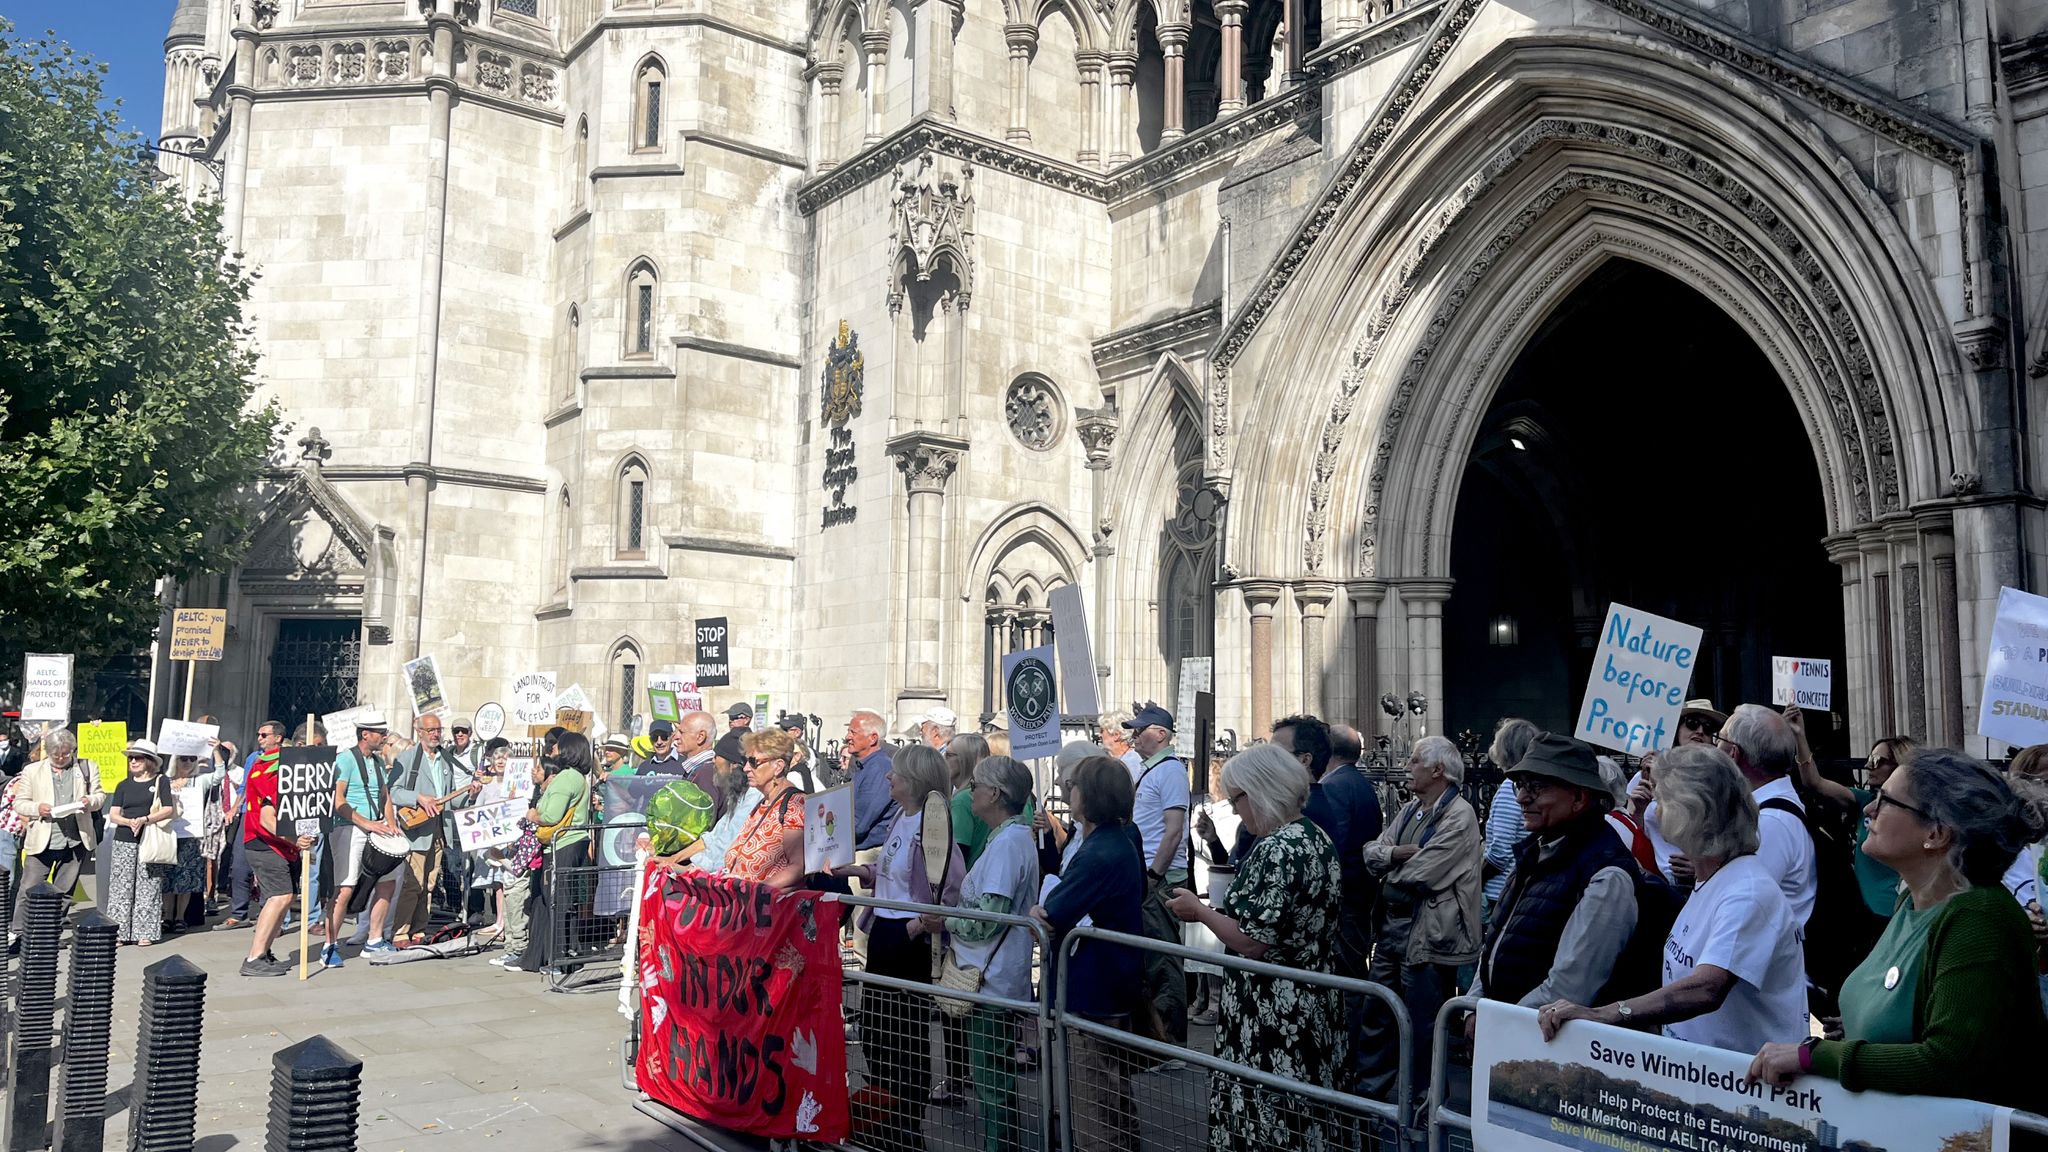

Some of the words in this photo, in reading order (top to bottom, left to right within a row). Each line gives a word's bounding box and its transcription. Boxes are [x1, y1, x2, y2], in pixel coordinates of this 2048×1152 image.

[830, 426, 851, 447] The
[825, 441, 854, 469] Royal
[823, 465, 857, 489] Courts
[833, 483, 846, 506] of
[821, 503, 856, 533] Justice
[177, 611, 208, 622] AELTC:
[210, 615, 225, 625] you
[176, 625, 212, 636] promised
[697, 626, 726, 643] STOP
[1606, 613, 1692, 669] Nature
[174, 637, 200, 647] NEVER
[201, 636, 210, 646] to
[700, 645, 720, 658] THE
[696, 663, 728, 677] STADIUM
[1021, 659, 1037, 668] SAVE
[1800, 661, 1829, 678] TENNIS
[27, 679, 52, 687] HANDS
[53, 679, 67, 687] OFF
[513, 675, 530, 694] LAND
[530, 674, 538, 686] IN
[539, 675, 556, 694] TRUST
[1603, 653, 1682, 706] before
[26, 690, 67, 698] PROTECTED
[526, 692, 541, 704] FOR
[1796, 690, 1829, 708] CONCRETE
[515, 708, 527, 722] ALL
[527, 713, 538, 723] OF
[1010, 705, 1044, 729] WIMBLEDON
[1585, 698, 1666, 753] Profit
[87, 729, 113, 741] SAVE
[1025, 732, 1048, 741] PROTECT
[278, 761, 337, 794] BERRY
[509, 762, 528, 774] SAVE
[277, 790, 336, 821] ANGRY
[463, 804, 512, 827] SAVE
[471, 822, 513, 844] PARK
[680, 953, 709, 1008] IN
[716, 955, 774, 1017] OUR
[669, 1023, 786, 1117] HANDS
[1590, 1040, 1635, 1069] Save
[1642, 1051, 1762, 1099] Wimbledon
[1770, 1083, 1822, 1113] Park
[1551, 1116, 1580, 1137] Save
[1559, 1100, 1588, 1119] Hold
[1591, 1108, 1637, 1133] Merton
[1641, 1126, 1666, 1141] and
[1670, 1129, 1718, 1152] AELTC
[1599, 1089, 1628, 1111] Help
[1632, 1098, 1680, 1124] Protect
[1684, 1112, 1706, 1130] the
[1710, 1118, 1808, 1152] Environment
